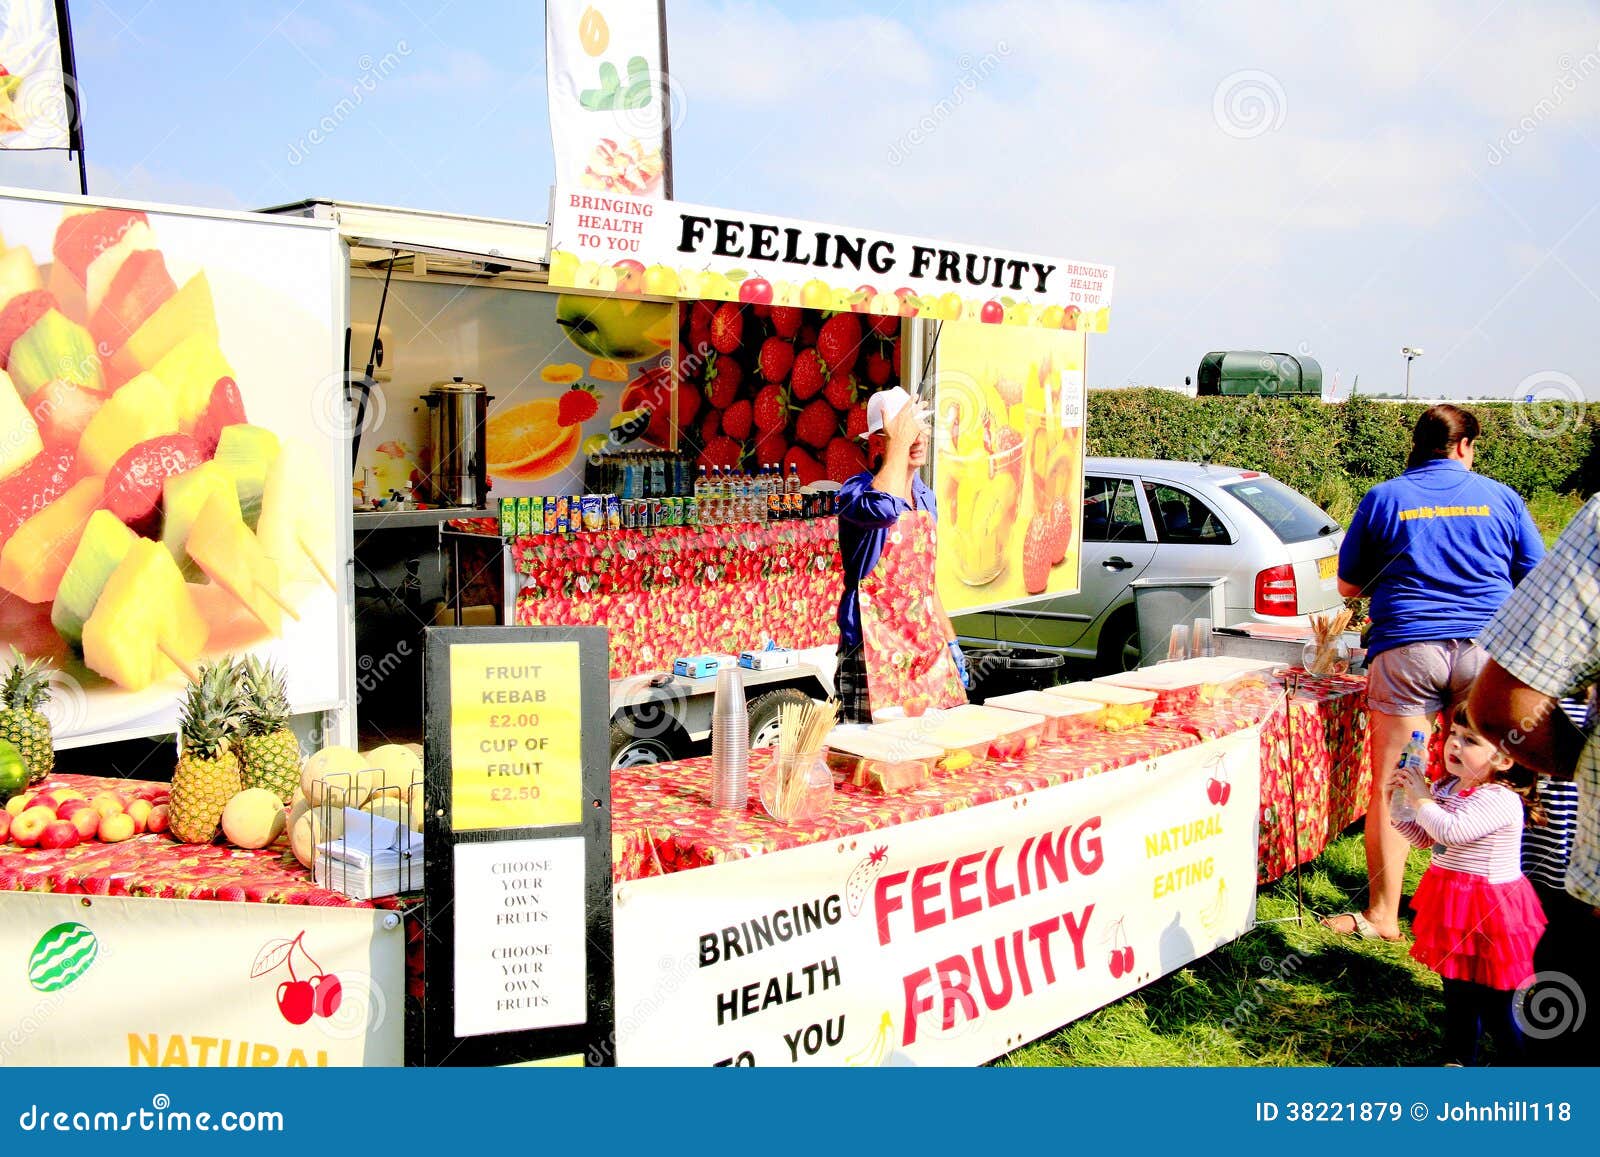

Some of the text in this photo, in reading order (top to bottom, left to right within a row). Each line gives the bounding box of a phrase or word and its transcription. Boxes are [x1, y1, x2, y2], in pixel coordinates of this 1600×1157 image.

[569, 194, 654, 218] BRINGING
[578, 214, 643, 235] HEALTH
[578, 233, 640, 252] TO YOU
[677, 214, 1056, 294] FEELING FRUITY
[1067, 265, 1109, 279] BRINGING
[1070, 278, 1103, 291] HEALTH
[1070, 291, 1100, 304] TO YOU
[486, 666, 542, 679] FRUIT
[482, 690, 547, 704] KEBAB
[489, 714, 540, 728] £2.00
[480, 738, 549, 753] CUP OF
[487, 762, 543, 777] FRUIT
[490, 786, 541, 801] £2.50
[1144, 813, 1224, 859] NATURAL
[491, 860, 553, 874] CHOOSE
[502, 878, 543, 891] YOUR
[873, 816, 1105, 946] FEELING
[1152, 856, 1215, 899] EATING
[504, 895, 540, 907] OWN
[496, 911, 549, 925] FRUITS
[699, 893, 843, 968] BRINGING
[491, 944, 553, 959] CHOOSE
[502, 962, 543, 976] YOUR
[901, 903, 1096, 1047] FRUITY
[504, 979, 541, 993] OWN
[716, 955, 841, 1026] HEALTH
[497, 996, 549, 1011] FRUITS
[783, 1014, 845, 1063] YOU
